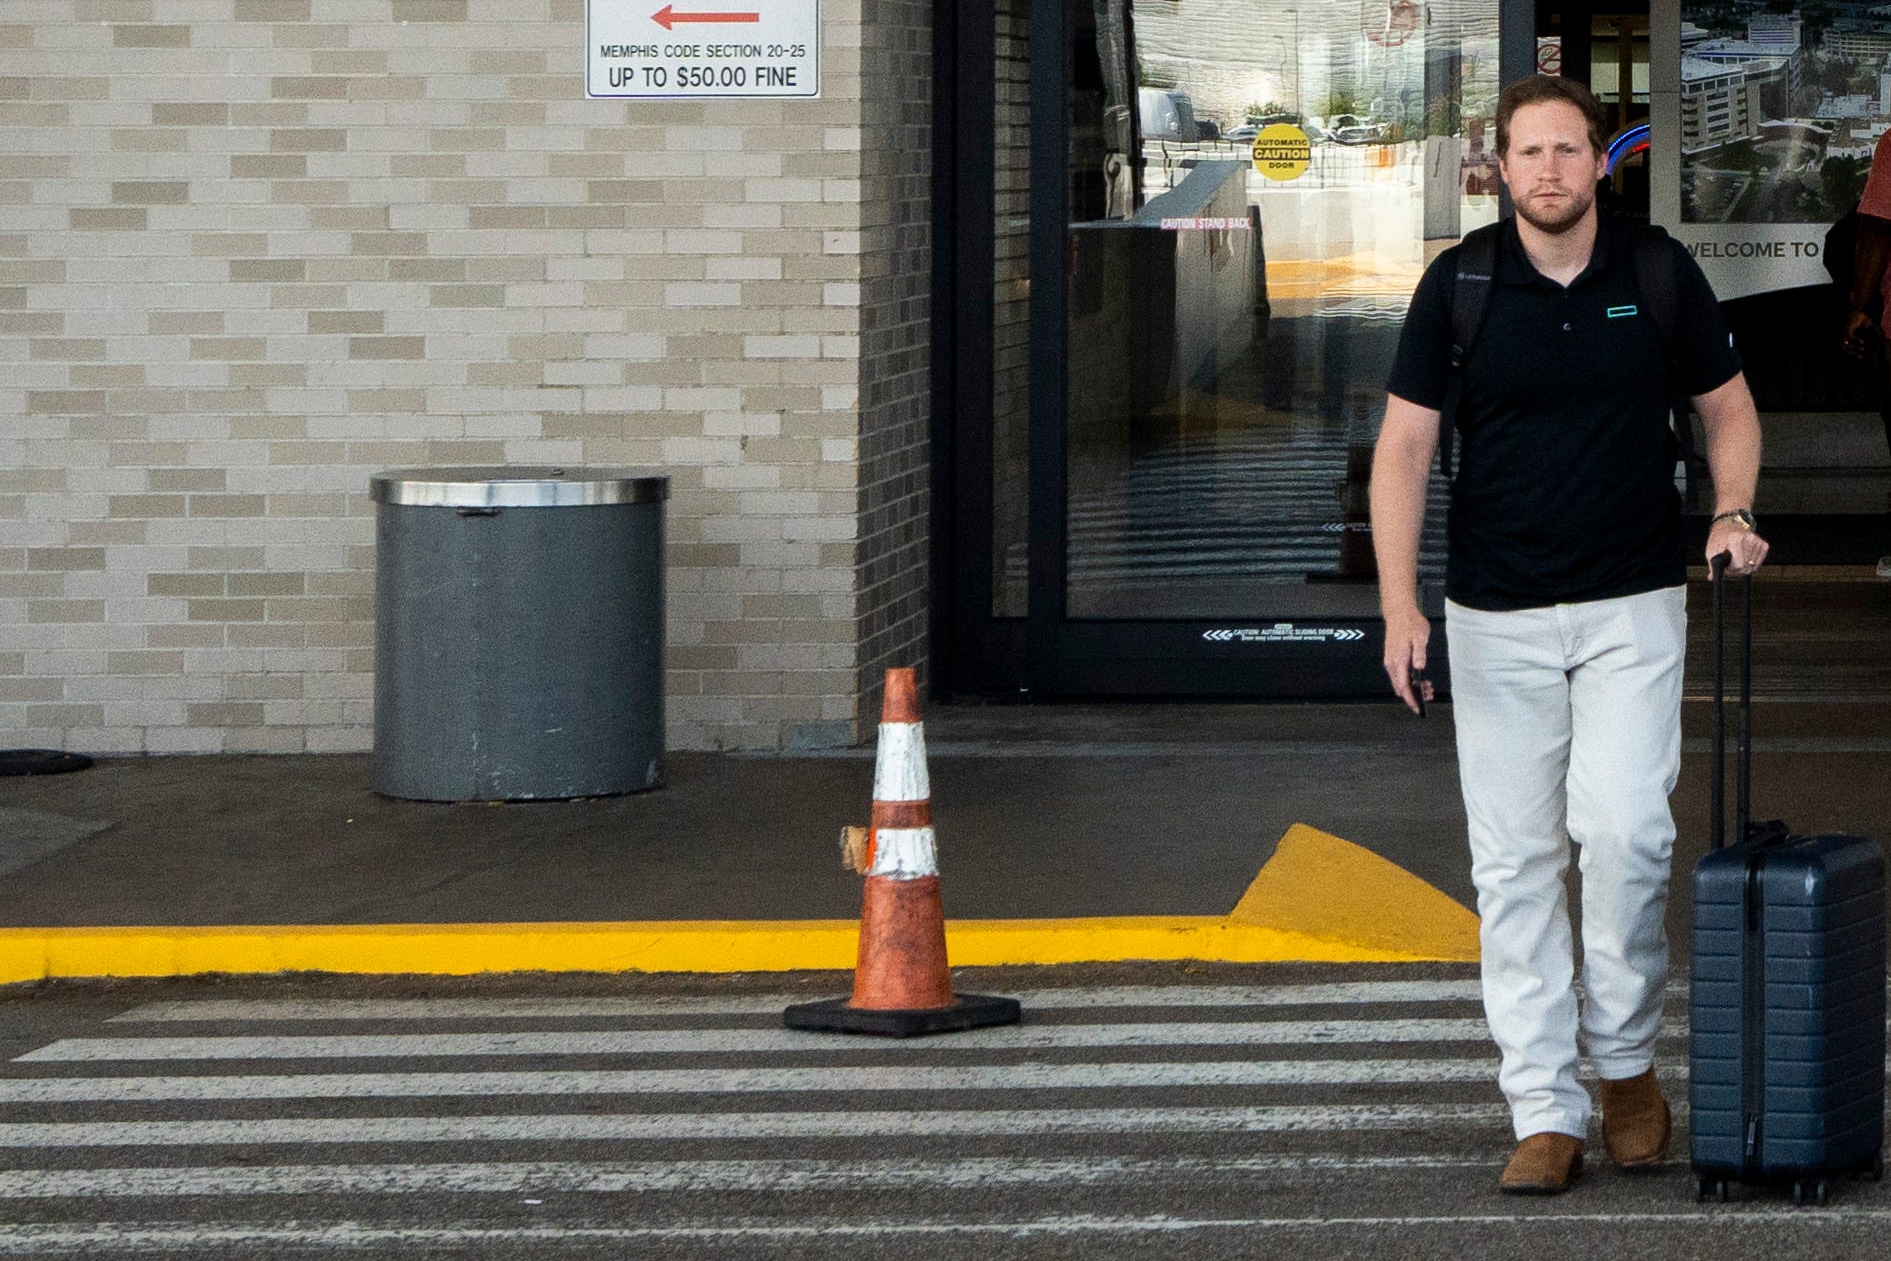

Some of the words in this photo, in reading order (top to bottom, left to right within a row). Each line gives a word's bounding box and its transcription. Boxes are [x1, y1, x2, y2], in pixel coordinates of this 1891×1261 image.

[600, 45, 658, 58] MEMPHIS
[664, 45, 700, 58] CODE
[706, 45, 761, 58] SECTION
[768, 45, 805, 58] 20-25
[609, 66, 634, 87] UP
[642, 66, 667, 87] TO
[677, 66, 746, 87] $50.00
[755, 66, 797, 87] FINE
[1255, 149, 1310, 159] CAUTION
[1161, 218, 1195, 229] CAUTION
[1199, 218, 1225, 229] STAND
[1228, 218, 1250, 229] BACK
[1790, 242, 1819, 258] TO
